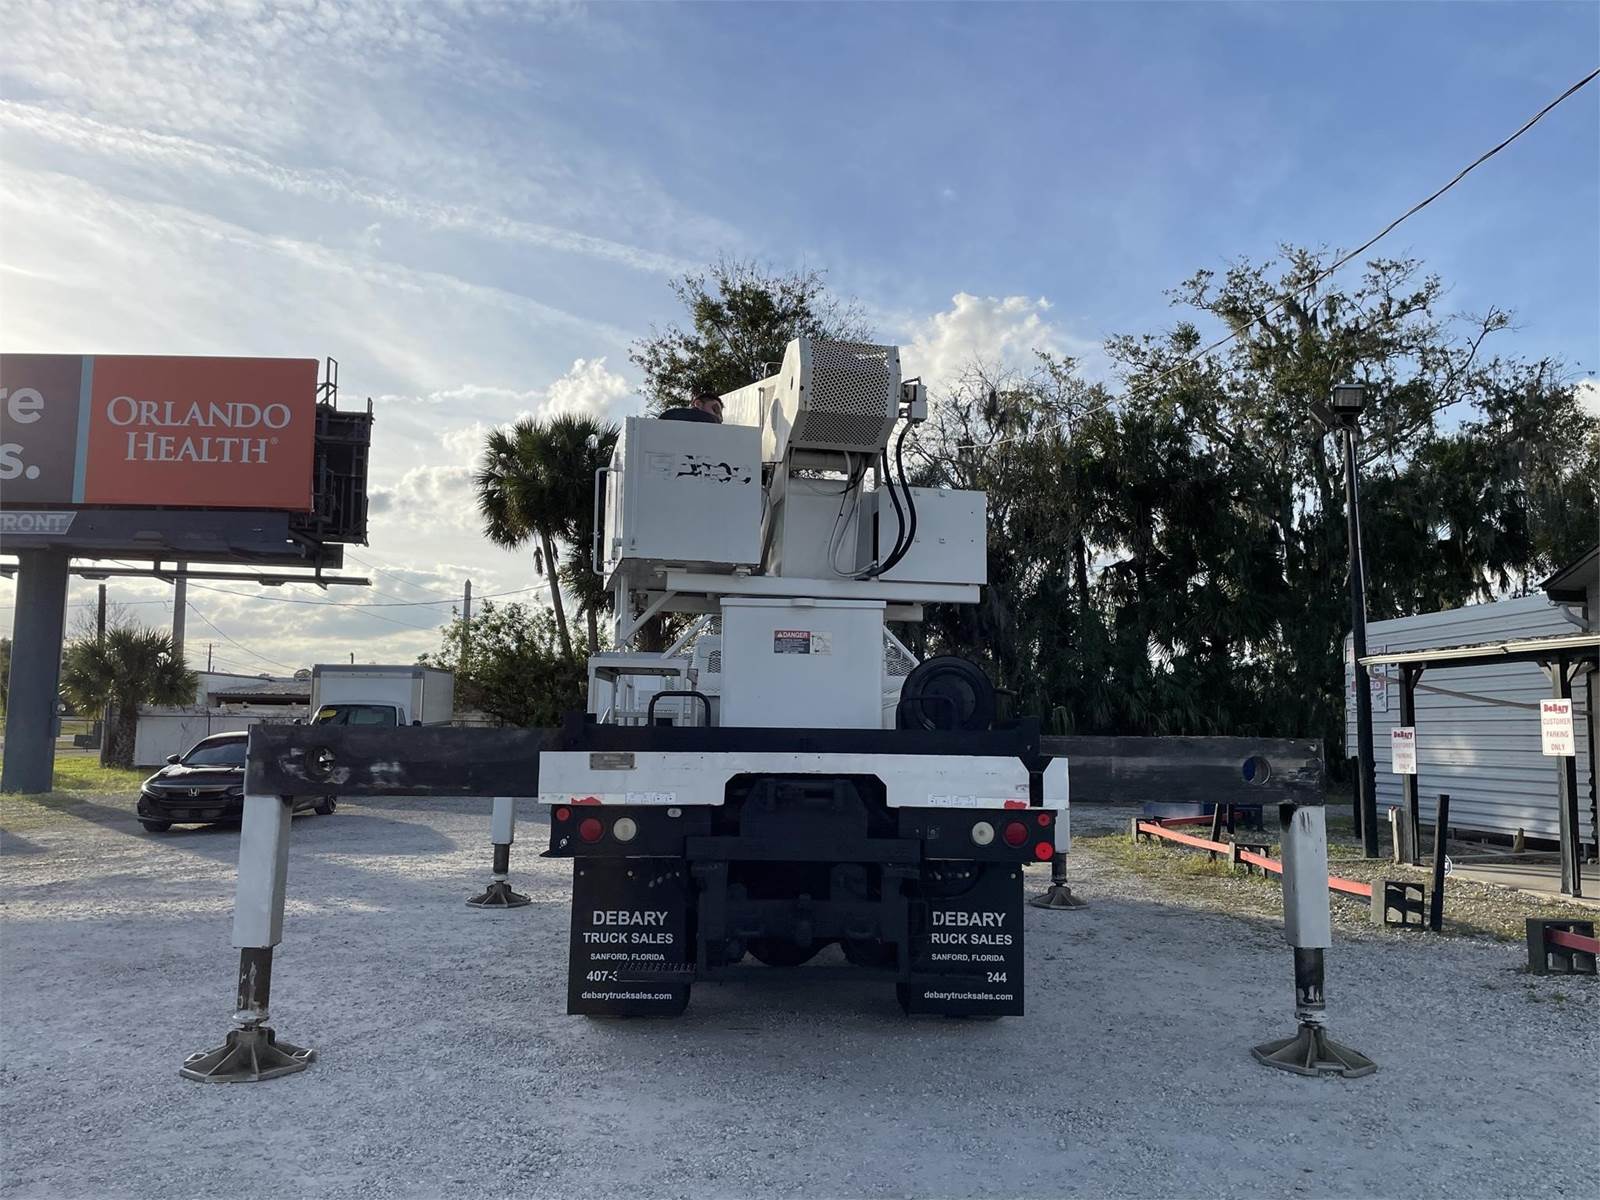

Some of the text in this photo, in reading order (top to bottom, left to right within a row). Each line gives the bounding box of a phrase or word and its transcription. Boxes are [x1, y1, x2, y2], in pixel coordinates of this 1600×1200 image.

[0, 387, 44, 424] e
[107, 396, 291, 429] ORLANDO
[0, 514, 66, 531] RONT
[592, 910, 668, 926] DEBARY
[932, 911, 1006, 927] DEBARY
[583, 932, 674, 944] TRUCK SALES
[970, 933, 1012, 945] SALES
[590, 953, 665, 961] SANFORD, FLORIDA
[931, 953, 1005, 962] SANFORD, FLORIDA
[581, 991, 673, 1001] debarytrucksales.com
[924, 991, 1014, 1001] debarytrucksales.com
